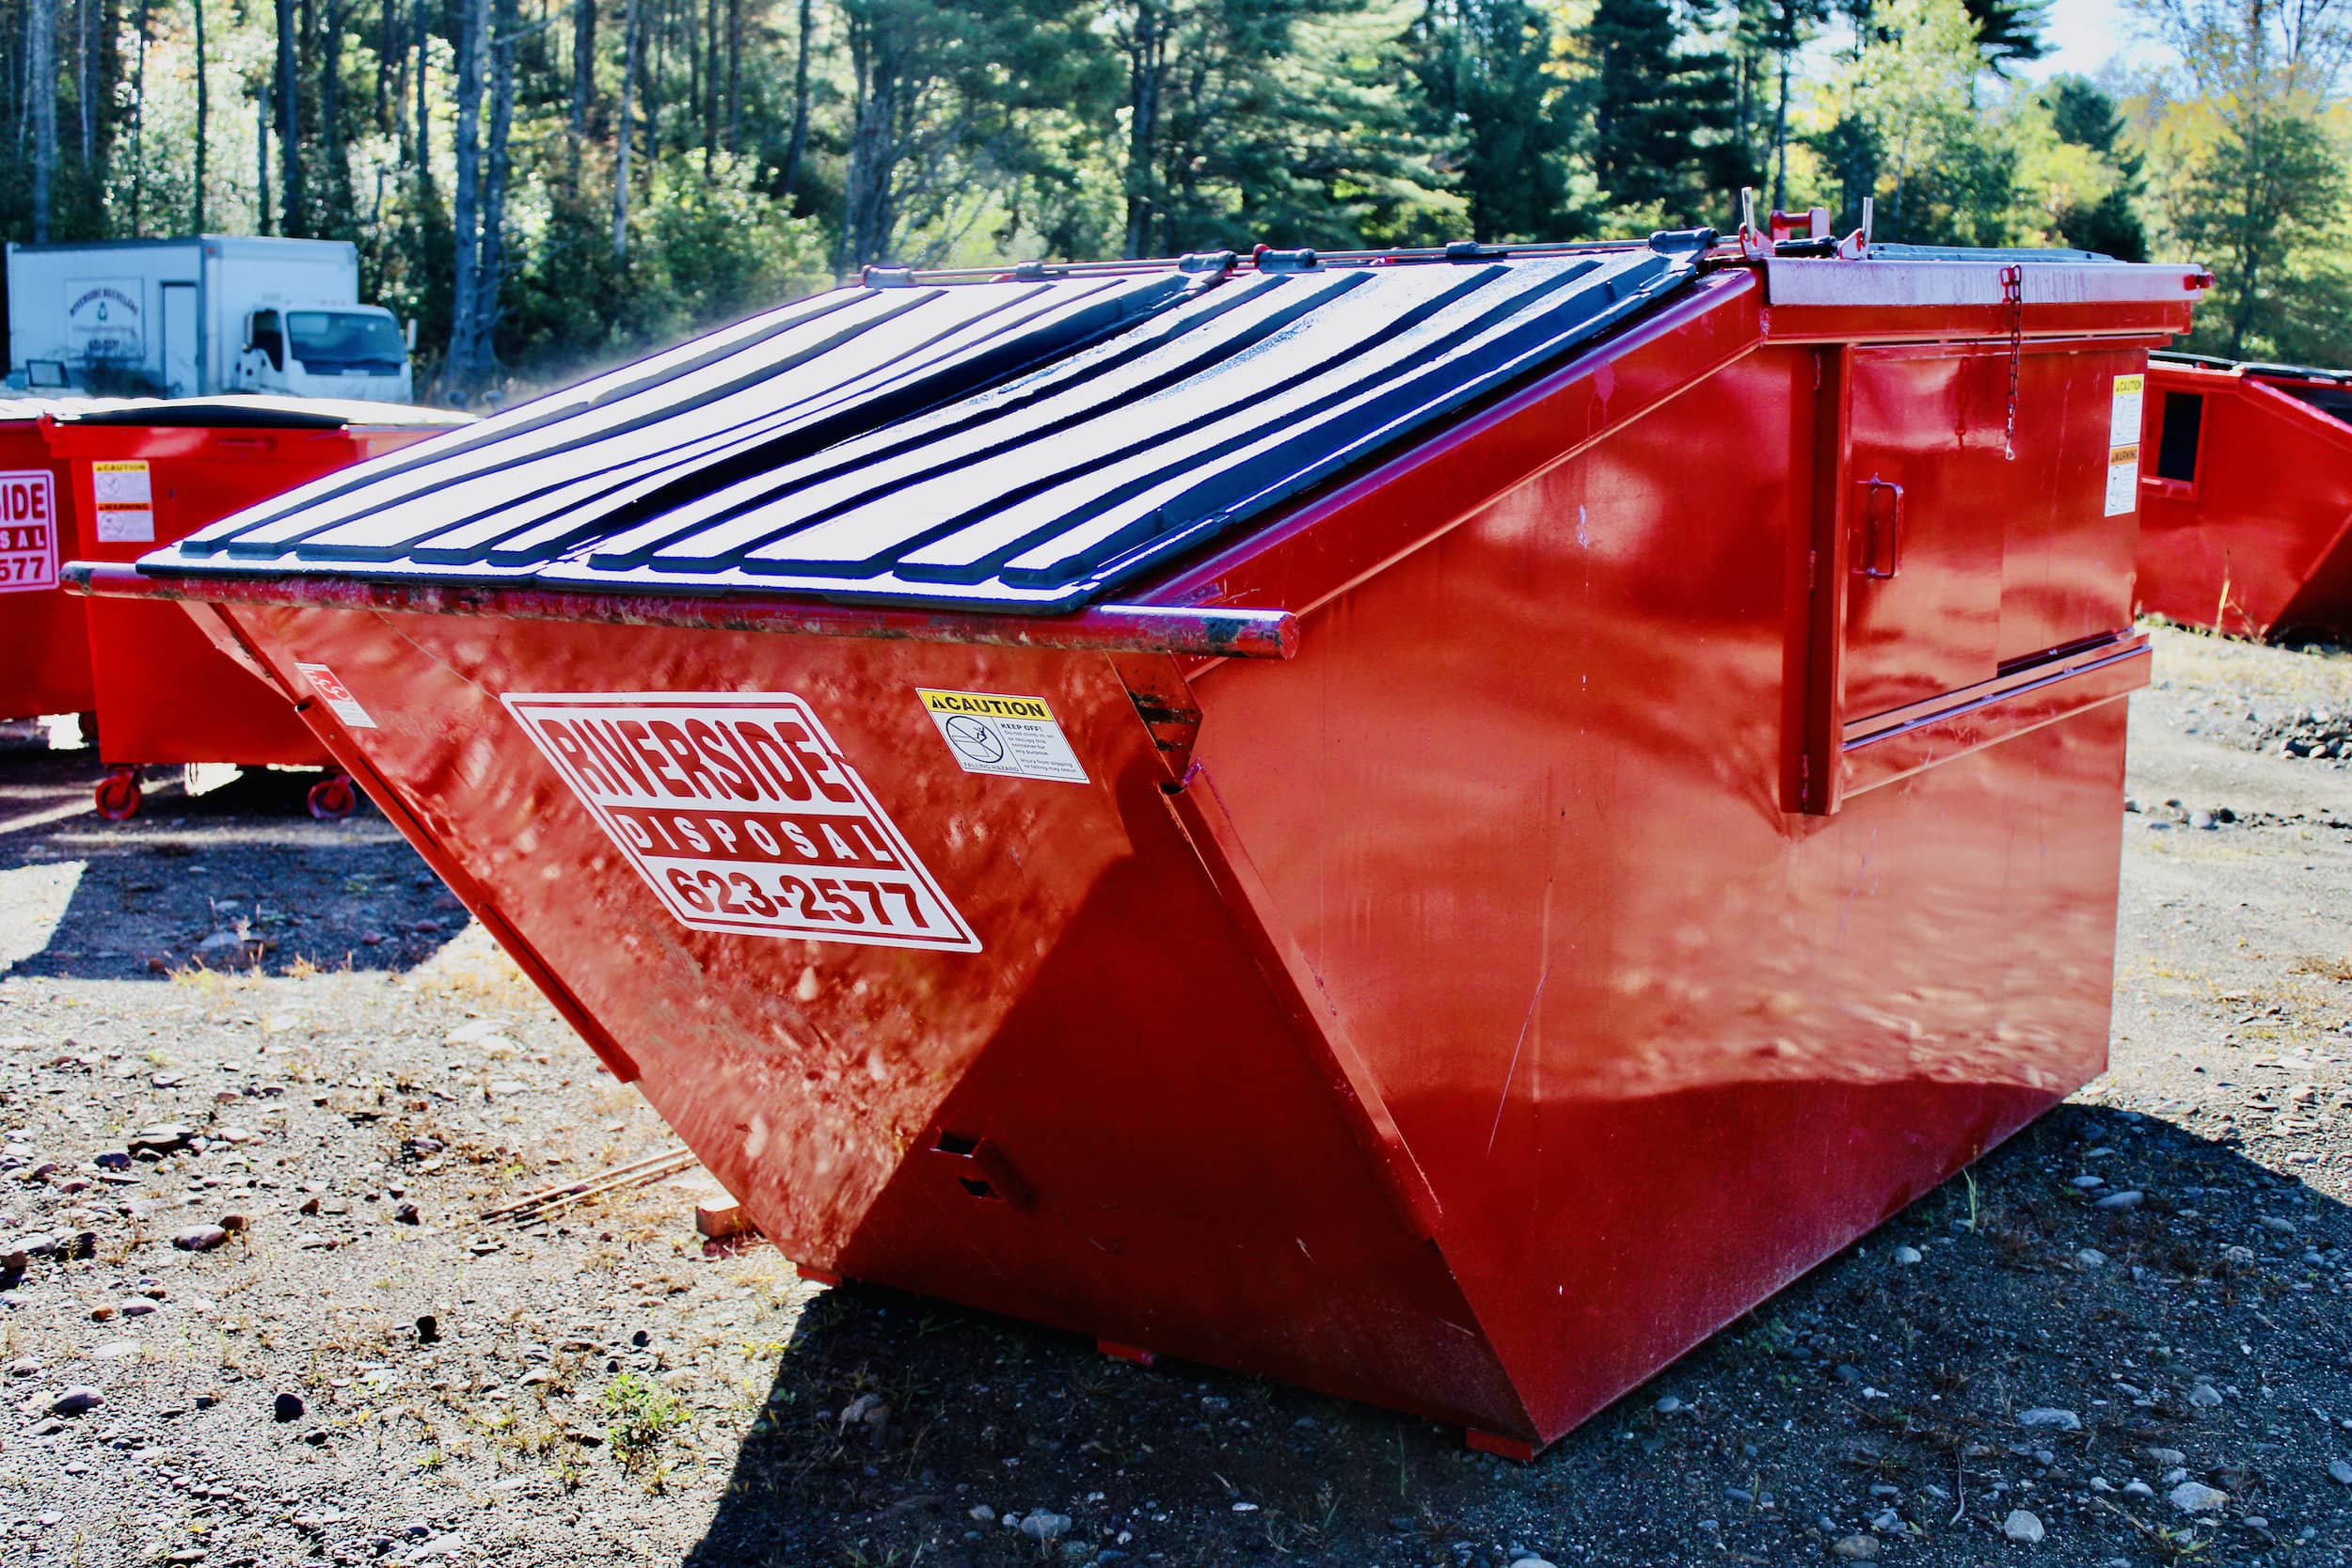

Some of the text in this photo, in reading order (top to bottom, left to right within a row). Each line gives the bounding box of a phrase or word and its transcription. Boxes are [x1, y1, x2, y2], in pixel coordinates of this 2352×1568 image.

[2120, 379, 2142, 392] CAUTION
[2116, 449, 2137, 462] WARNING
[0, 483, 46, 521] IDE
[945, 696, 1045, 717] CAUTION
[538, 718, 855, 802] RIVERSIDE
[614, 814, 889, 863] DISPOSAL
[665, 867, 930, 927] 623-2577
